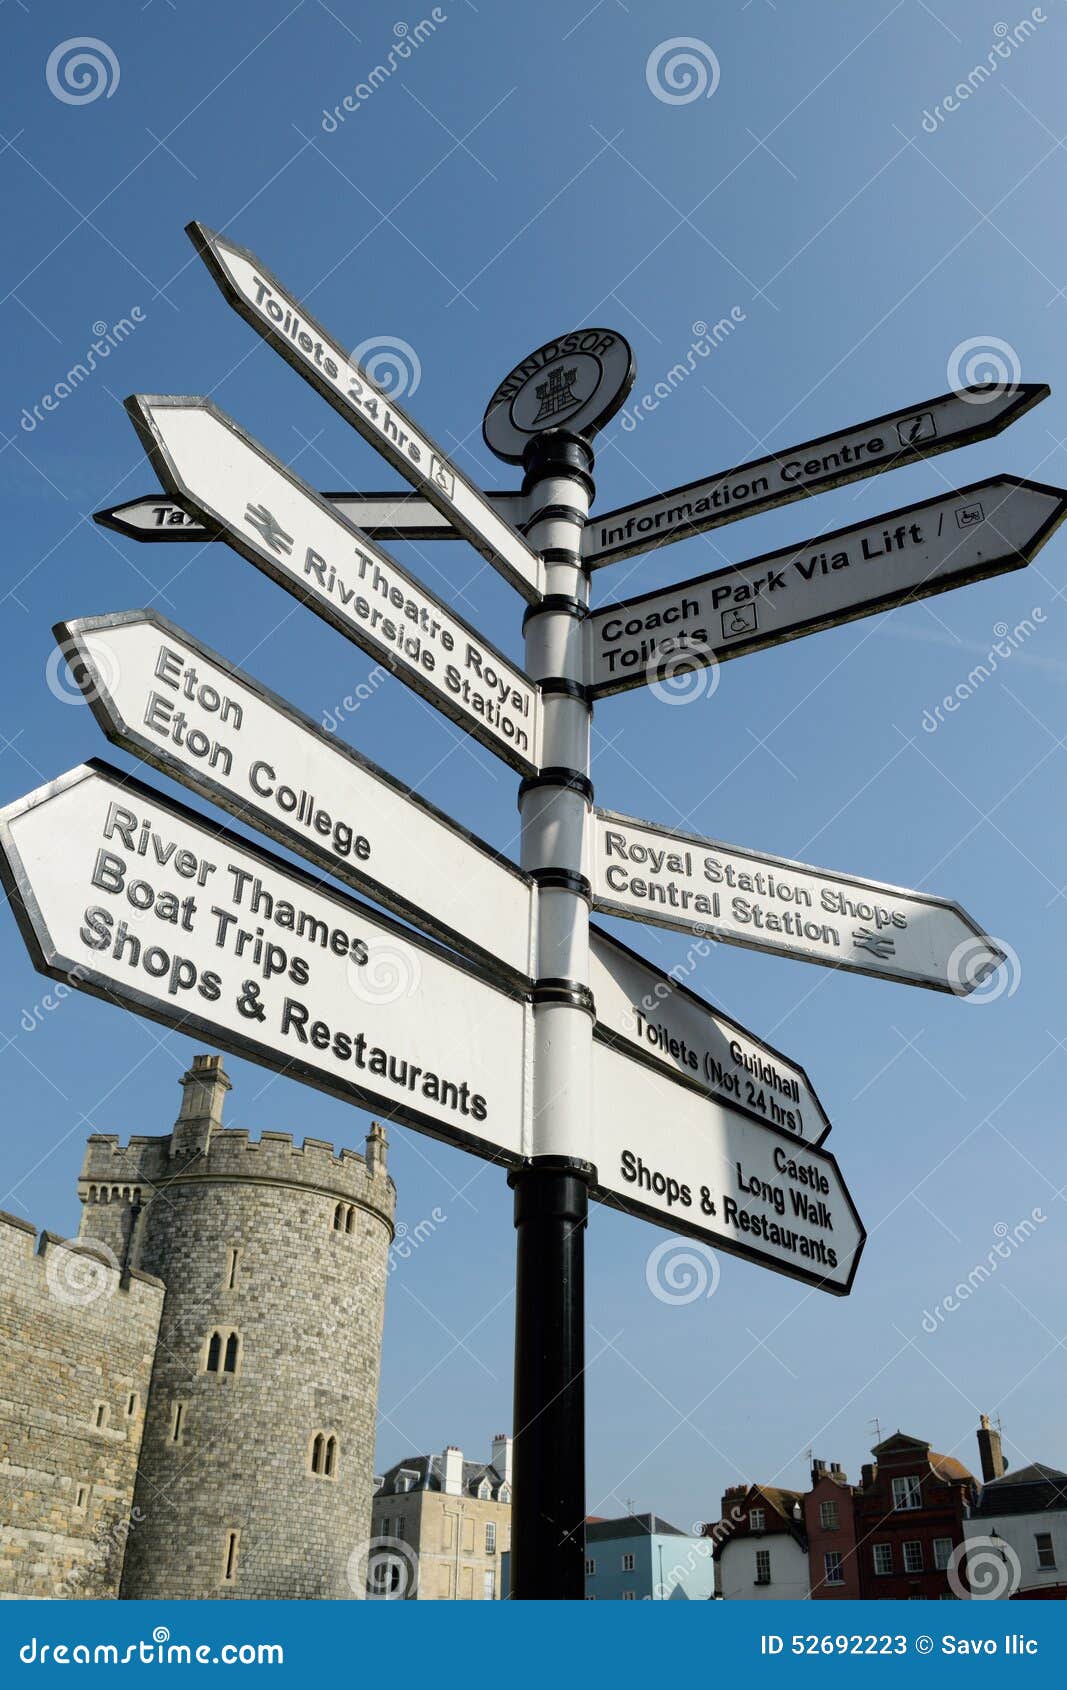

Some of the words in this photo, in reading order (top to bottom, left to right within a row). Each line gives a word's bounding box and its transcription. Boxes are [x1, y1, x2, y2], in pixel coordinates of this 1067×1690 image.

[253, 275, 339, 380] Toilets
[493, 332, 615, 404] WINDSOR
[601, 476, 769, 547] Information
[780, 437, 885, 482] Centre
[354, 547, 455, 652] Theatre
[464, 642, 530, 718] Royal
[601, 599, 700, 642] Coach
[711, 571, 787, 610] Park
[794, 551, 850, 580] Via
[861, 523, 924, 560] Lift
[154, 645, 244, 731] Eton
[303, 546, 436, 672] Riverside
[443, 664, 529, 751] Station
[602, 627, 709, 673] Toilets
[143, 690, 233, 776] Eton
[249, 760, 371, 861] College
[90, 848, 197, 932] Boat
[210, 905, 311, 986] Trips
[102, 800, 216, 887] River
[228, 863, 370, 966] Thames
[604, 830, 693, 877] Royal
[704, 857, 812, 907] Station
[820, 887, 908, 930] Shops
[605, 865, 721, 917] Central
[732, 896, 840, 946] Station
[79, 904, 223, 1002] Shops
[236, 979, 267, 1023] &
[280, 996, 488, 1122] Restaurants
[632, 1006, 699, 1070] Toilets
[704, 1052, 742, 1098] (Not
[745, 1081, 767, 1114] 24
[769, 1096, 804, 1136] hrs)
[729, 1040, 801, 1104] Guildhall
[620, 1149, 693, 1207] Shops
[699, 1186, 717, 1217] &
[723, 1194, 839, 1268] Restaurants
[736, 1162, 786, 1215] Long
[789, 1187, 833, 1231] Walk
[773, 1147, 829, 1195] Castle
